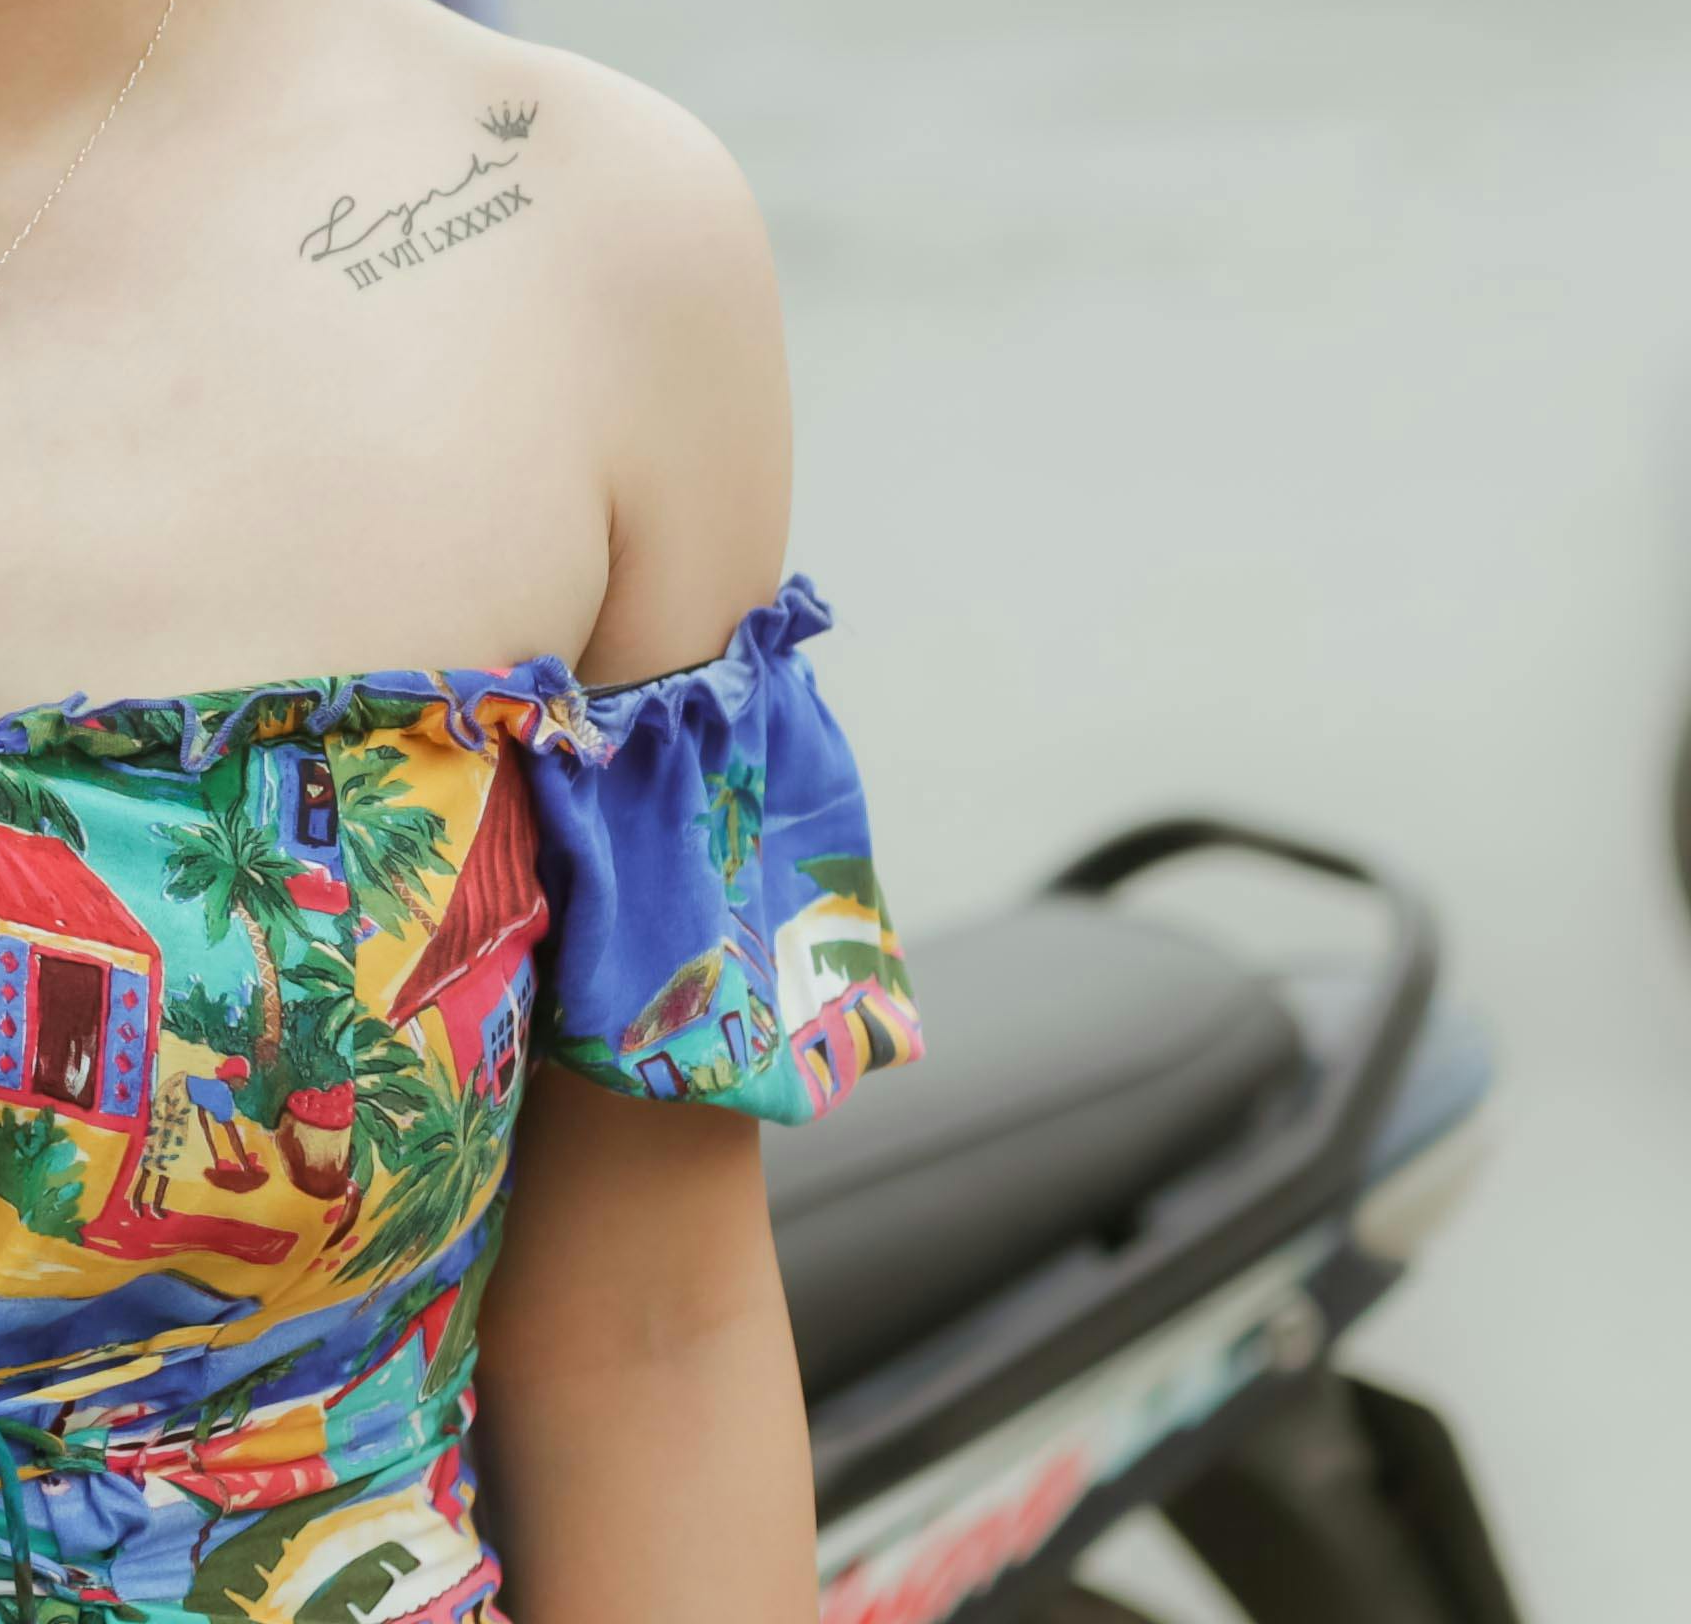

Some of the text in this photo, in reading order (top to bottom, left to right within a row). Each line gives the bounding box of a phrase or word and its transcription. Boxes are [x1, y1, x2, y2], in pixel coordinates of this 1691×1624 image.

[343, 183, 533, 290] III VII LXXXIX
